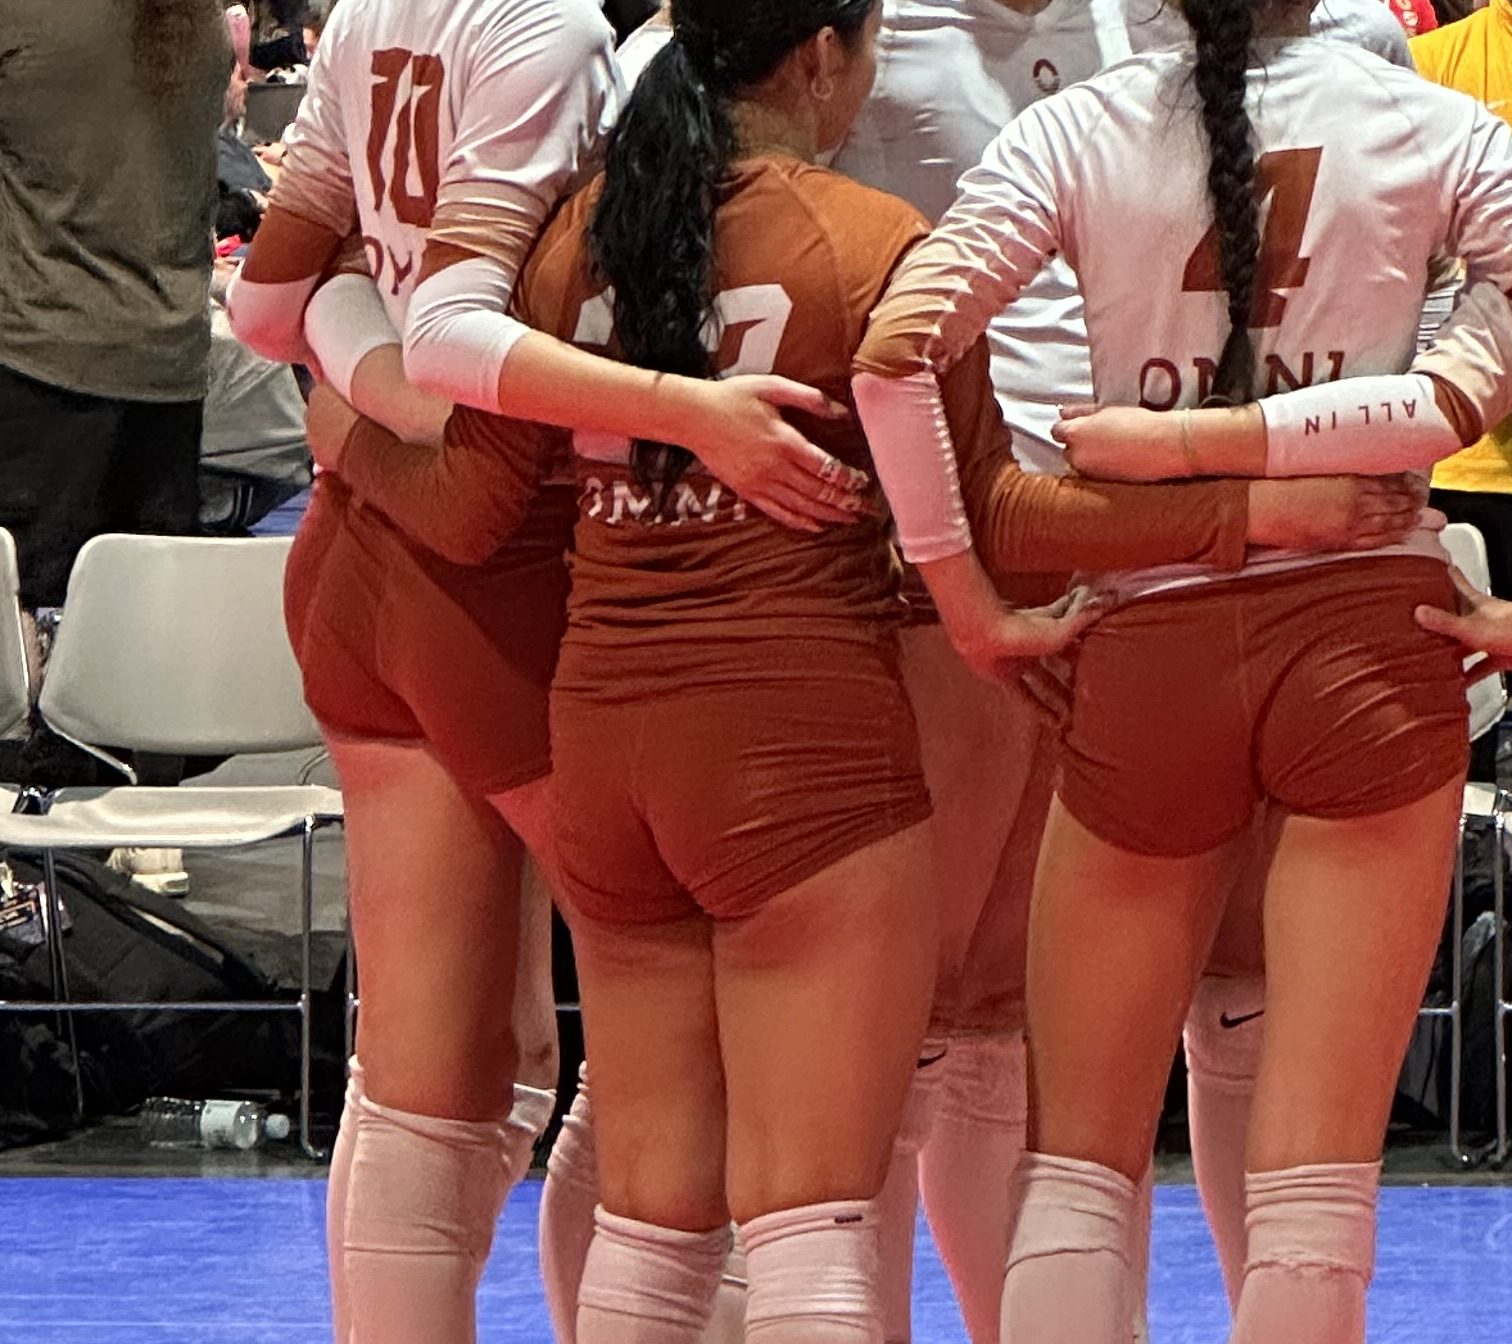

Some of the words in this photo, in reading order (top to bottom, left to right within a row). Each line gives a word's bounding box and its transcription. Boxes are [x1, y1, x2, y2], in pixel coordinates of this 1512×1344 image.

[366, 46, 444, 228] 10
[1181, 145, 1324, 328] 4
[1304, 411, 1337, 435] IN
[1358, 398, 1416, 424] ALL
